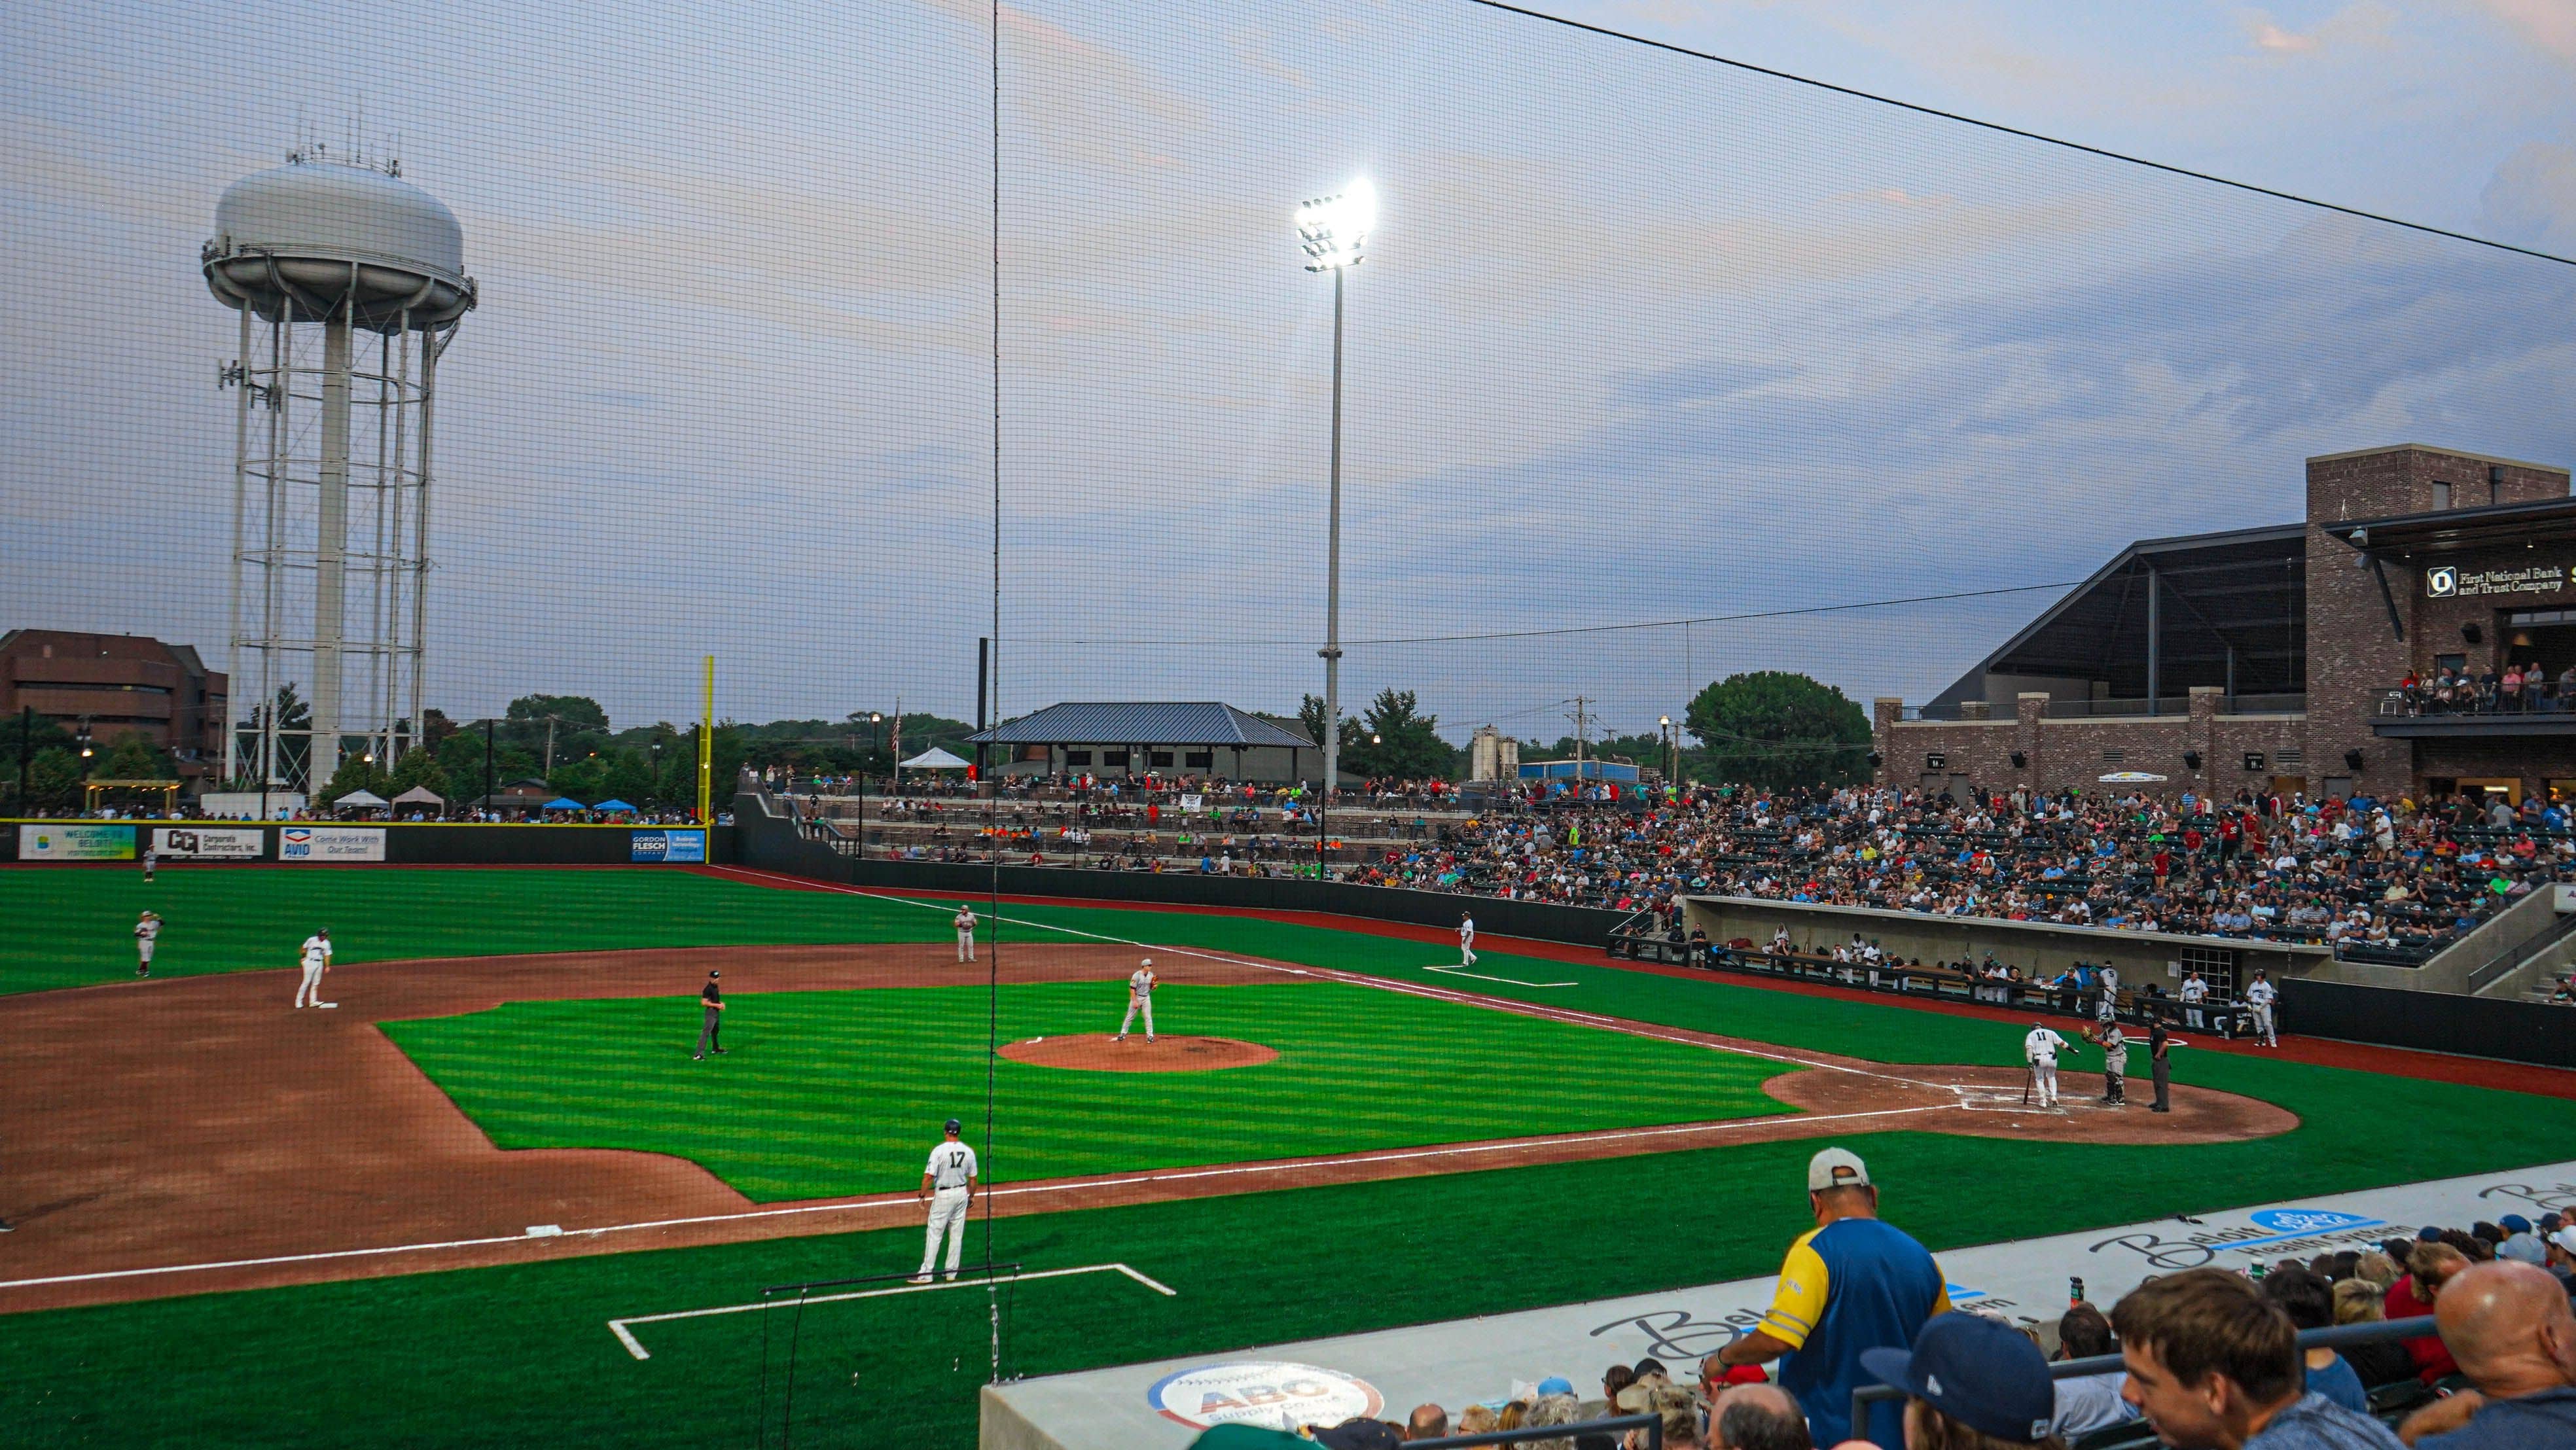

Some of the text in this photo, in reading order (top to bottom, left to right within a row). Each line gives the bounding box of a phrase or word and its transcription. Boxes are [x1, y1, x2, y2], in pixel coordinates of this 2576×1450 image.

[2459, 573, 2484, 584] First
[2486, 568, 2531, 582] National
[2532, 566, 2562, 579] Bank
[2459, 580, 2562, 595] and Trust Company
[65, 830, 109, 839] WELCOME
[285, 843, 310, 856] AVID
[2036, 1031, 2047, 1041] 11
[949, 1151, 965, 1169] 17
[2088, 1226, 2276, 1269] Beloit
[2233, 1225, 2420, 1257] Health System
[1200, 1378, 1329, 1413] ABC
[1208, 1404, 1274, 1422] Supply
